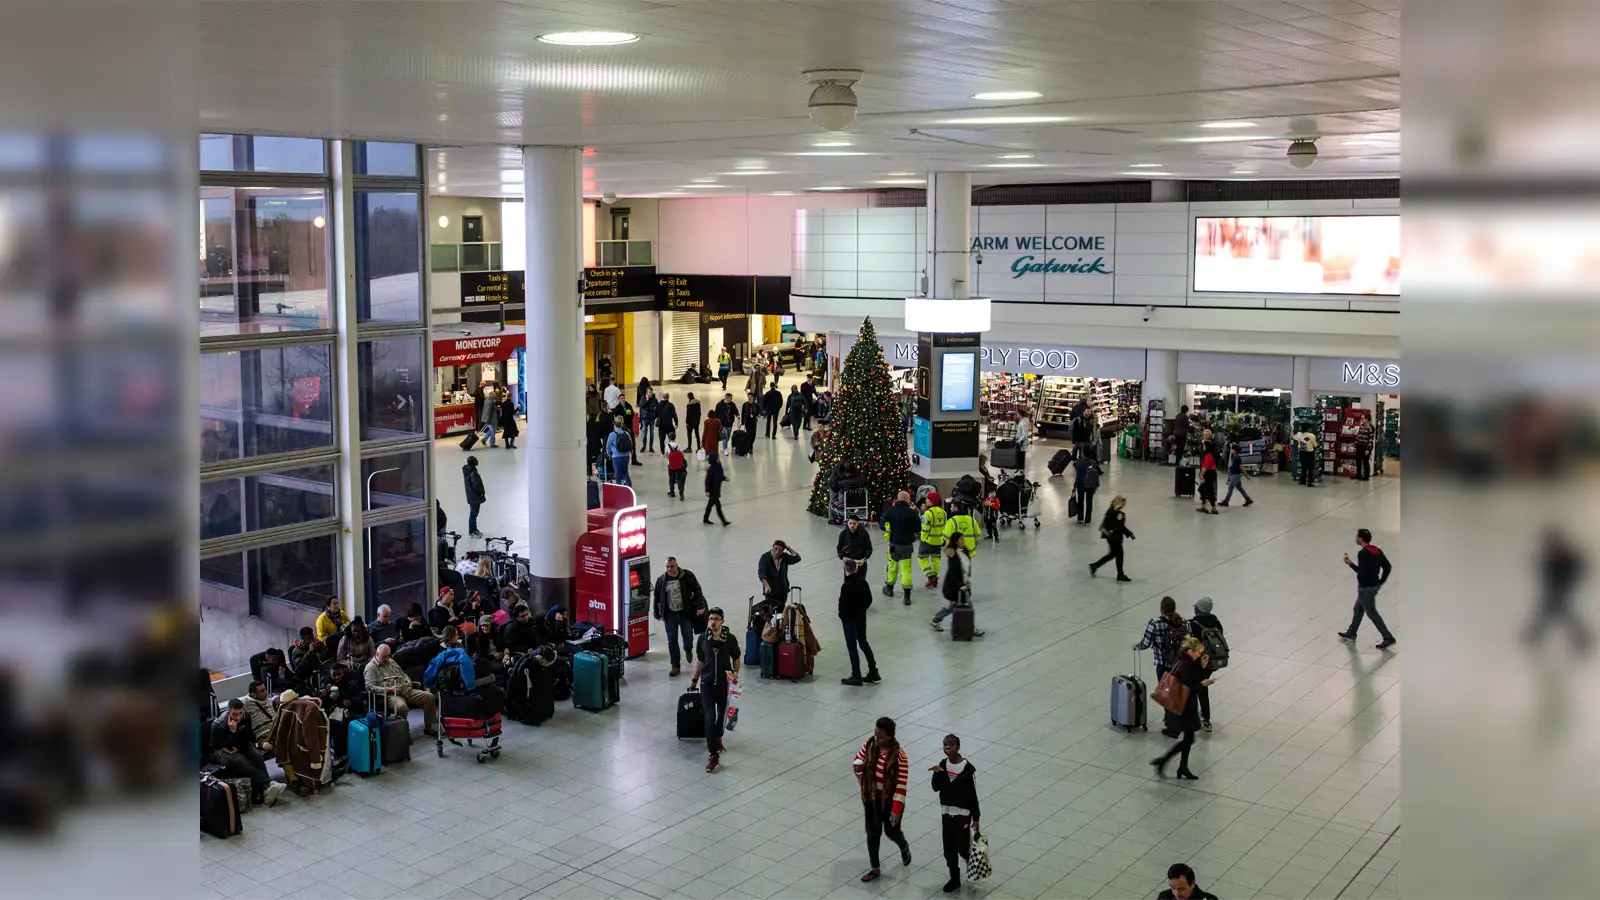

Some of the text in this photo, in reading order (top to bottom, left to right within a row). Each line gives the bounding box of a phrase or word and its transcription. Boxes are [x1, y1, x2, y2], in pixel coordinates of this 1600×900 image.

[971, 236, 1106, 251] ARM WELCOME
[1010, 255, 1113, 280] Gatwick
[590, 269, 611, 277] Check-in
[488, 274, 502, 282] Taxis
[676, 278, 687, 286] Exit
[486, 284, 502, 292] rental
[676, 288, 691, 296] Taxis
[485, 294, 502, 302] Hotels
[676, 299, 704, 307] Car rental
[709, 314, 724, 322] Airport
[455, 337, 501, 350] MONEYCORP
[439, 352, 494, 362] Currency Exchange
[895, 343, 1080, 371] M& PLY FOOD
[1343, 361, 1400, 386] M&S
[434, 412, 464, 421] ommission
[588, 599, 606, 611] atm
